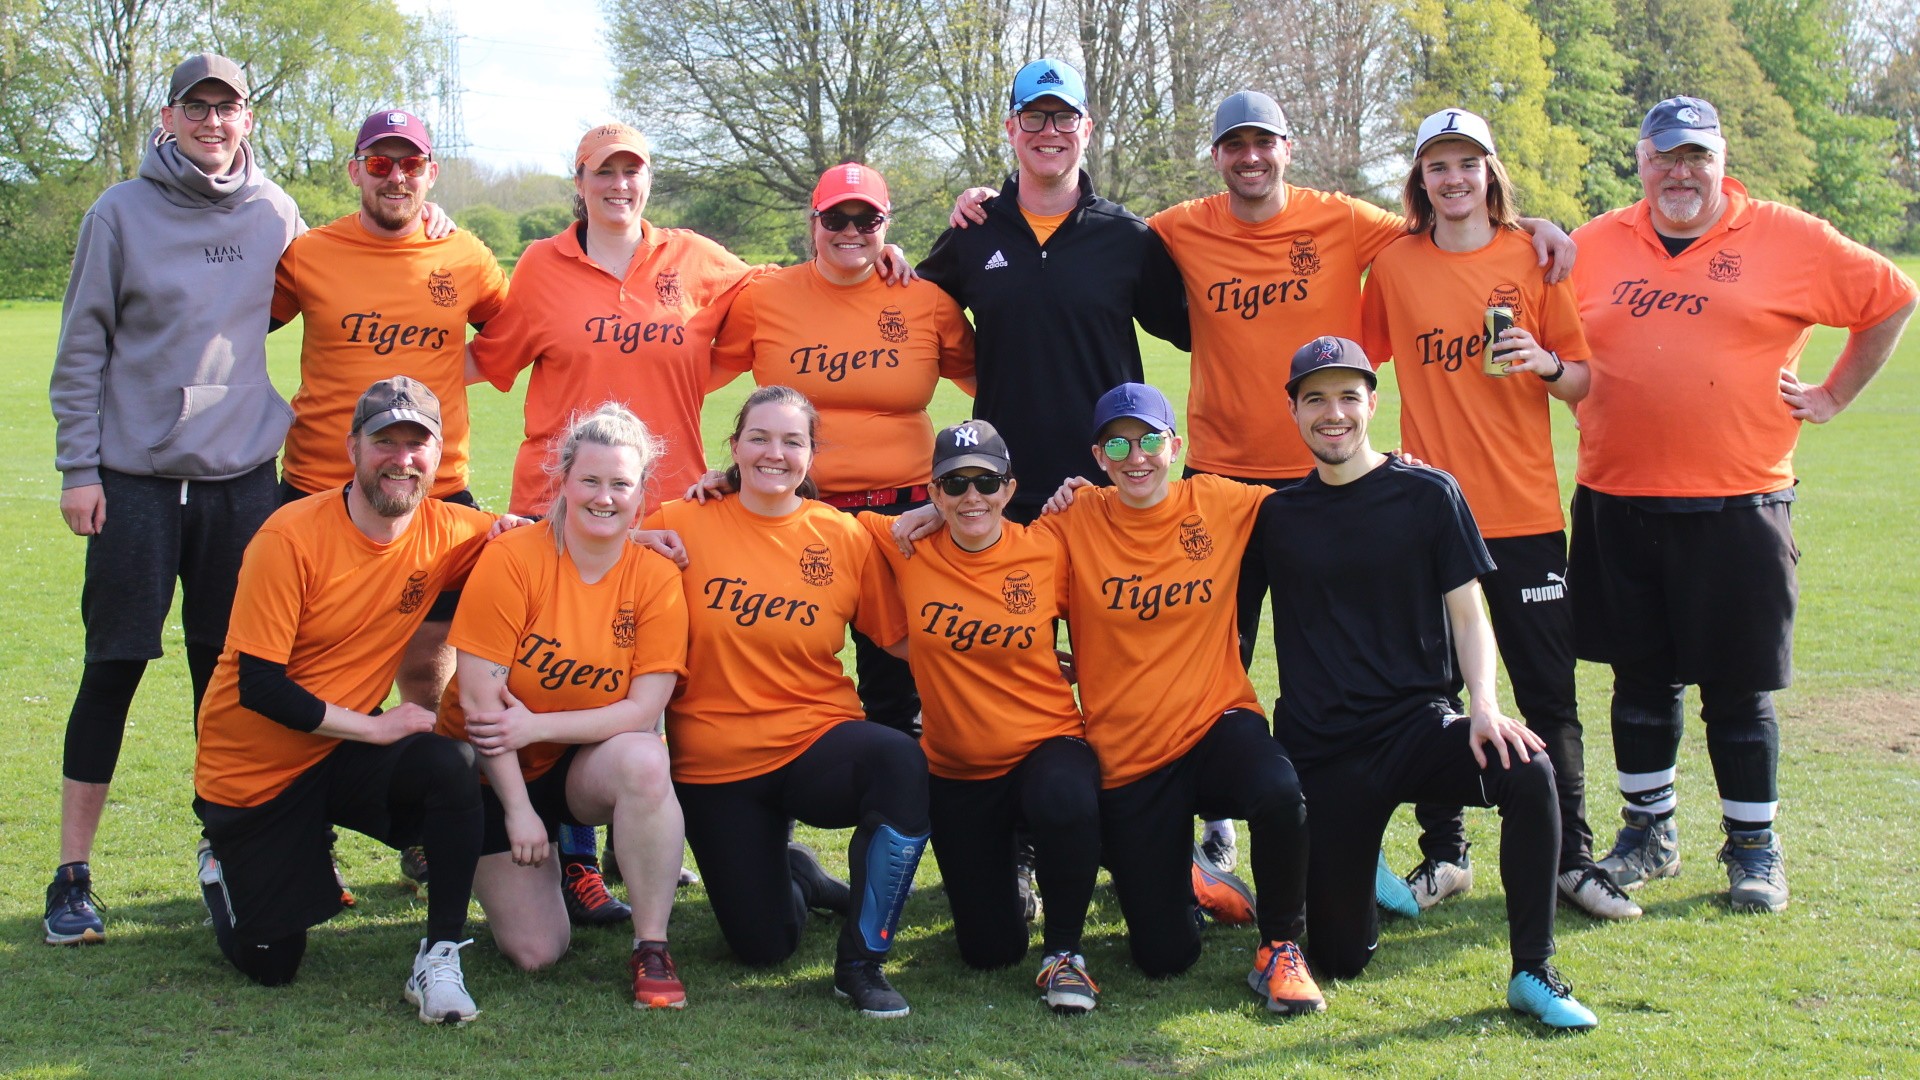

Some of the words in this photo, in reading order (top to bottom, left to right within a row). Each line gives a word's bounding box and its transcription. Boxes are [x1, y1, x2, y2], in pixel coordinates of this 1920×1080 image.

[1037, 77, 1064, 85] adidas
[985, 261, 1008, 270] adidas
[1208, 278, 1309, 320] Tigers
[1612, 279, 1709, 318] Tigers
[341, 312, 449, 356] Tigers
[585, 315, 685, 354] Tigers
[1416, 327, 1482, 372] Tige
[790, 344, 899, 383] Tigers
[955, 426, 979, 447] NY
[806, 554, 829, 564] Tigers
[704, 577, 820, 627] Tigers
[1007, 582, 1030, 592] Tigers
[1102, 574, 1213, 621] Tigers
[1521, 583, 1563, 603] PUMA
[921, 601, 1036, 652] Tigers
[517, 633, 624, 693] Tigers
